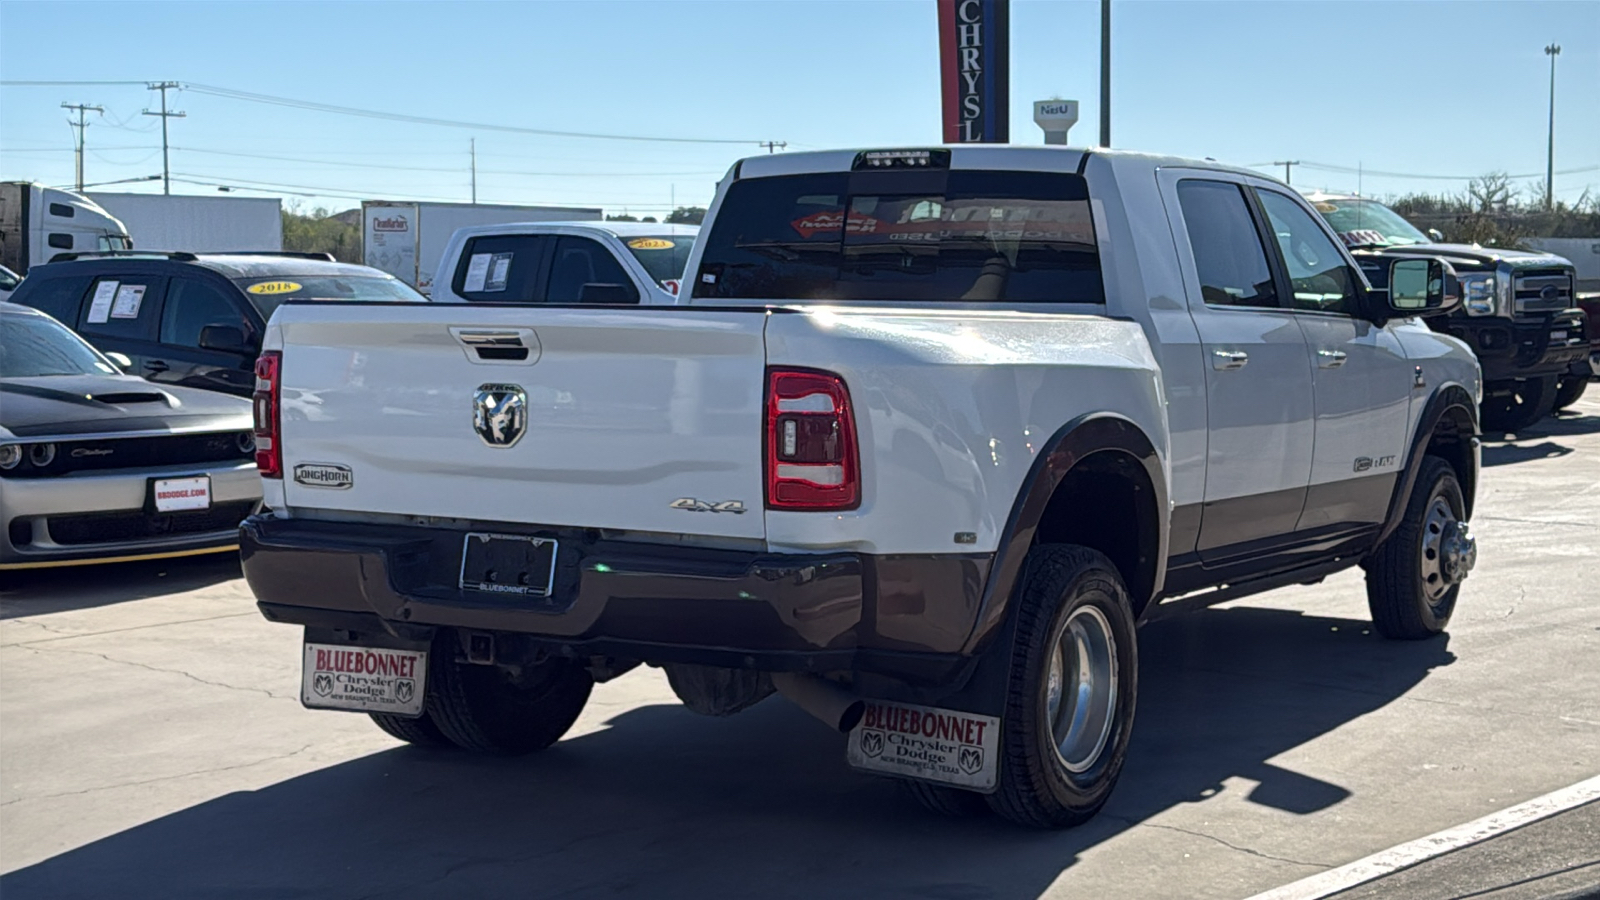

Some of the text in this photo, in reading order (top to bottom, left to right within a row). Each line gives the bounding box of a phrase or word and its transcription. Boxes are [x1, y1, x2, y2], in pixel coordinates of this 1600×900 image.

[1040, 105, 1068, 115] NBU
[259, 282, 292, 293] 2018
[157, 488, 206, 499] BBDODGE.COM
[480, 582, 528, 594] BLUEBONNET
[315, 649, 417, 677] BLUEBONNET
[336, 674, 394, 687] Chrysler
[344, 684, 385, 696] Dodge
[864, 704, 987, 746] BLUEBONNET
[887, 733, 957, 753] Chrysler
[896, 746, 946, 763] Dodge
[938, 764, 960, 775] TEXAS
